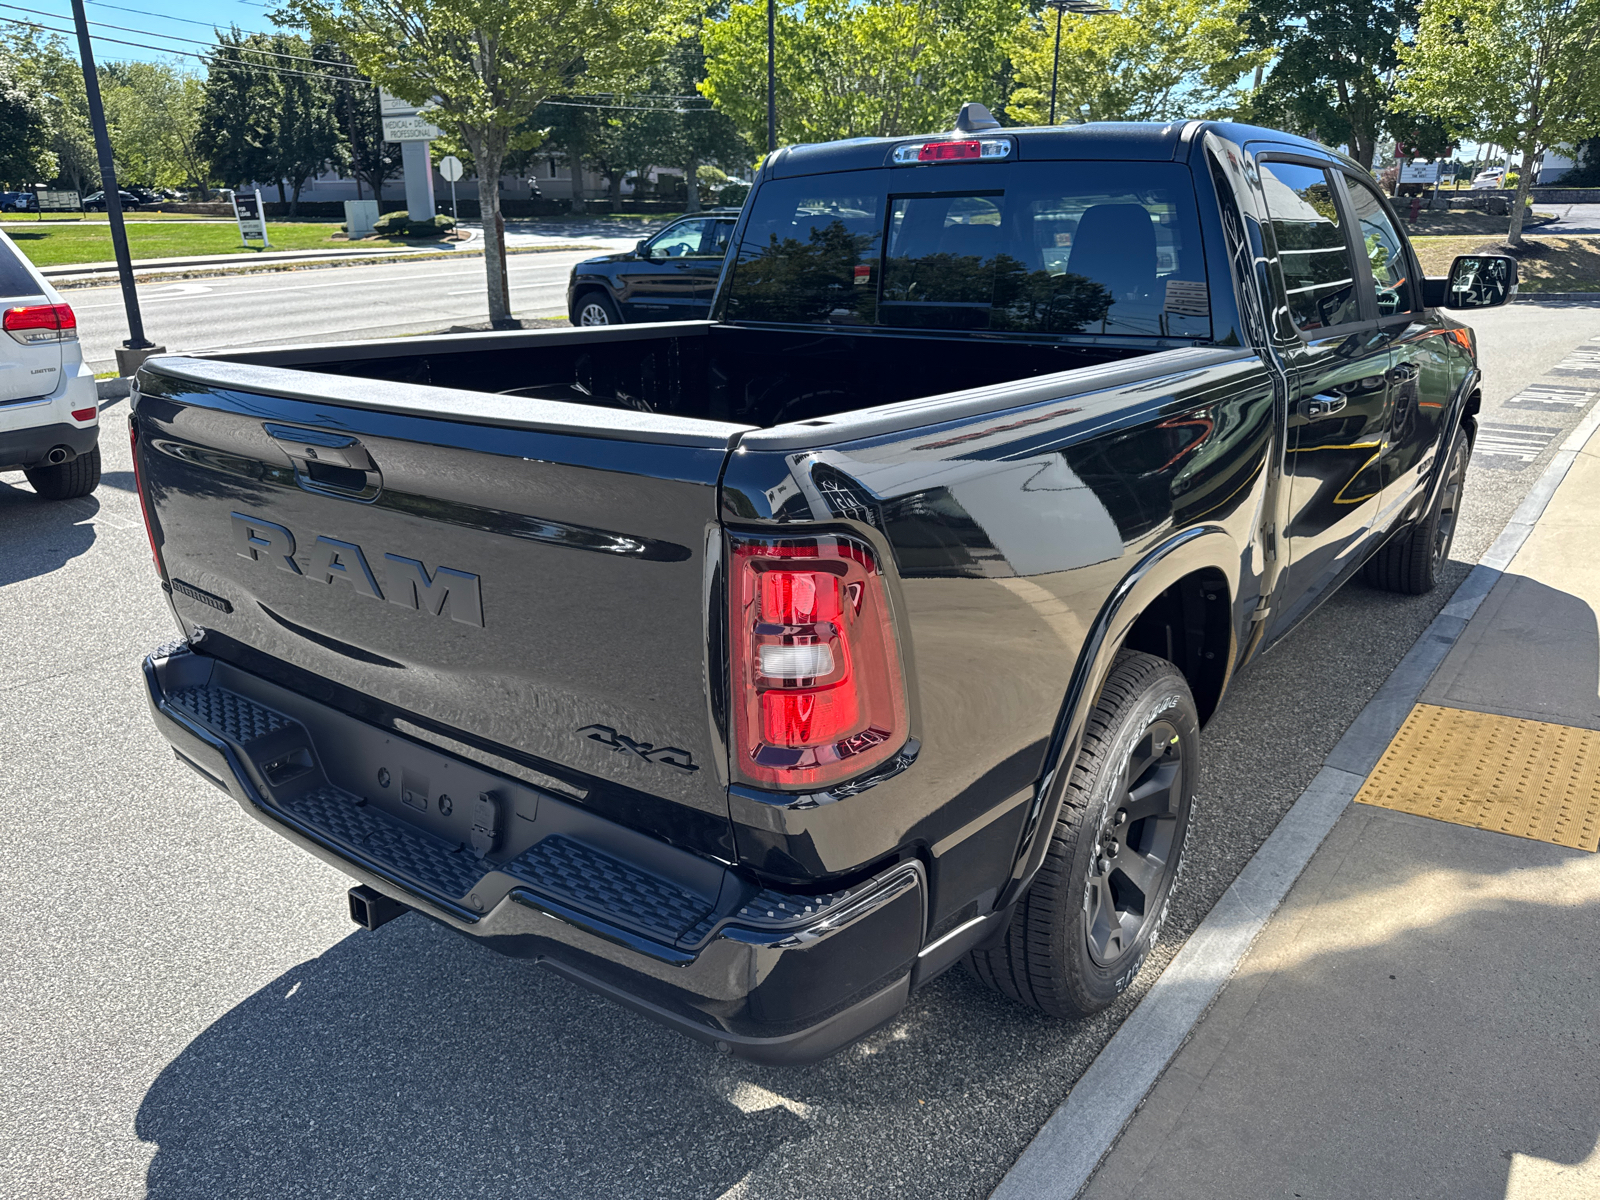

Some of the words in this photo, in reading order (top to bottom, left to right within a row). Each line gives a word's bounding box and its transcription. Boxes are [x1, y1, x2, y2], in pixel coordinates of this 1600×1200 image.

[385, 120, 408, 129] MEDICAL
[390, 129, 431, 138] PROFESSIONAL
[231, 511, 485, 628] RAM
